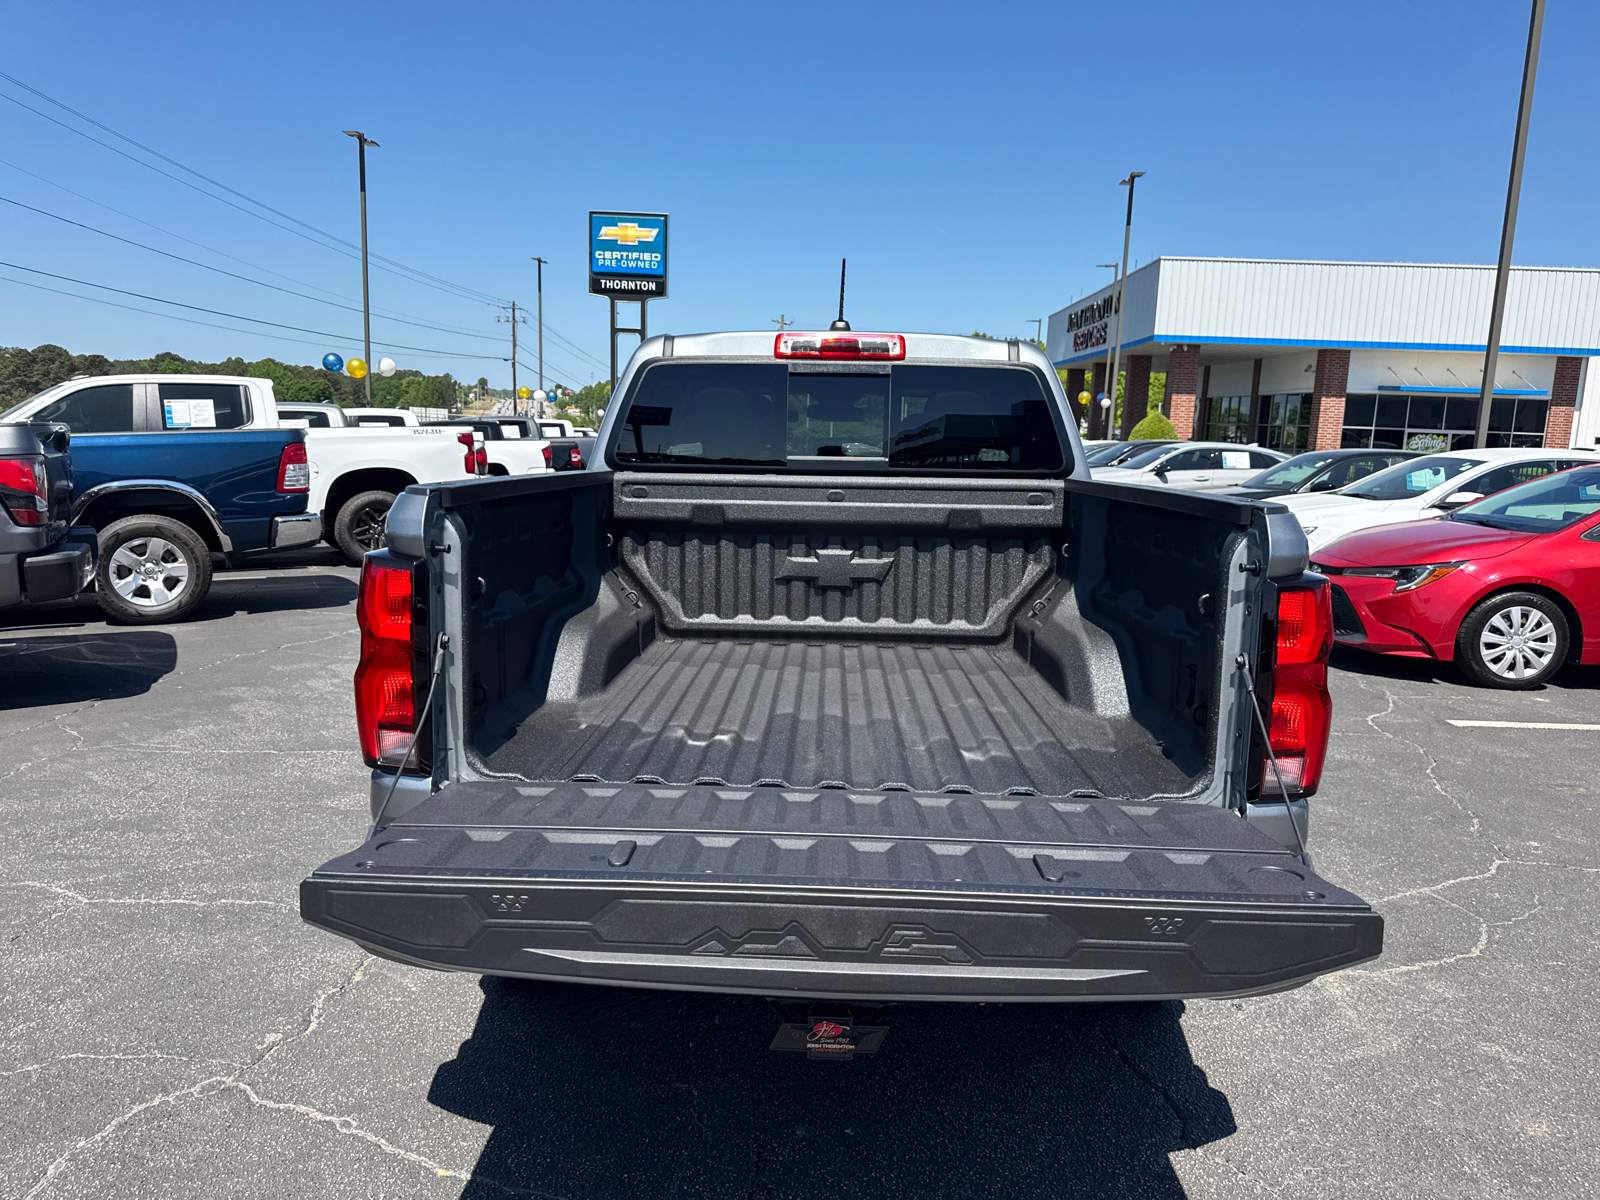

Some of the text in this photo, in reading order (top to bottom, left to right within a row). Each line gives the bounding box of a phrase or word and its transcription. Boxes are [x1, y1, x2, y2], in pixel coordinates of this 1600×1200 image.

[595, 250, 661, 261] CERTIFIED
[598, 259, 658, 268] PRE-OWNED
[600, 279, 656, 291] THORNTON
[1409, 434, 1443, 451] Spring
